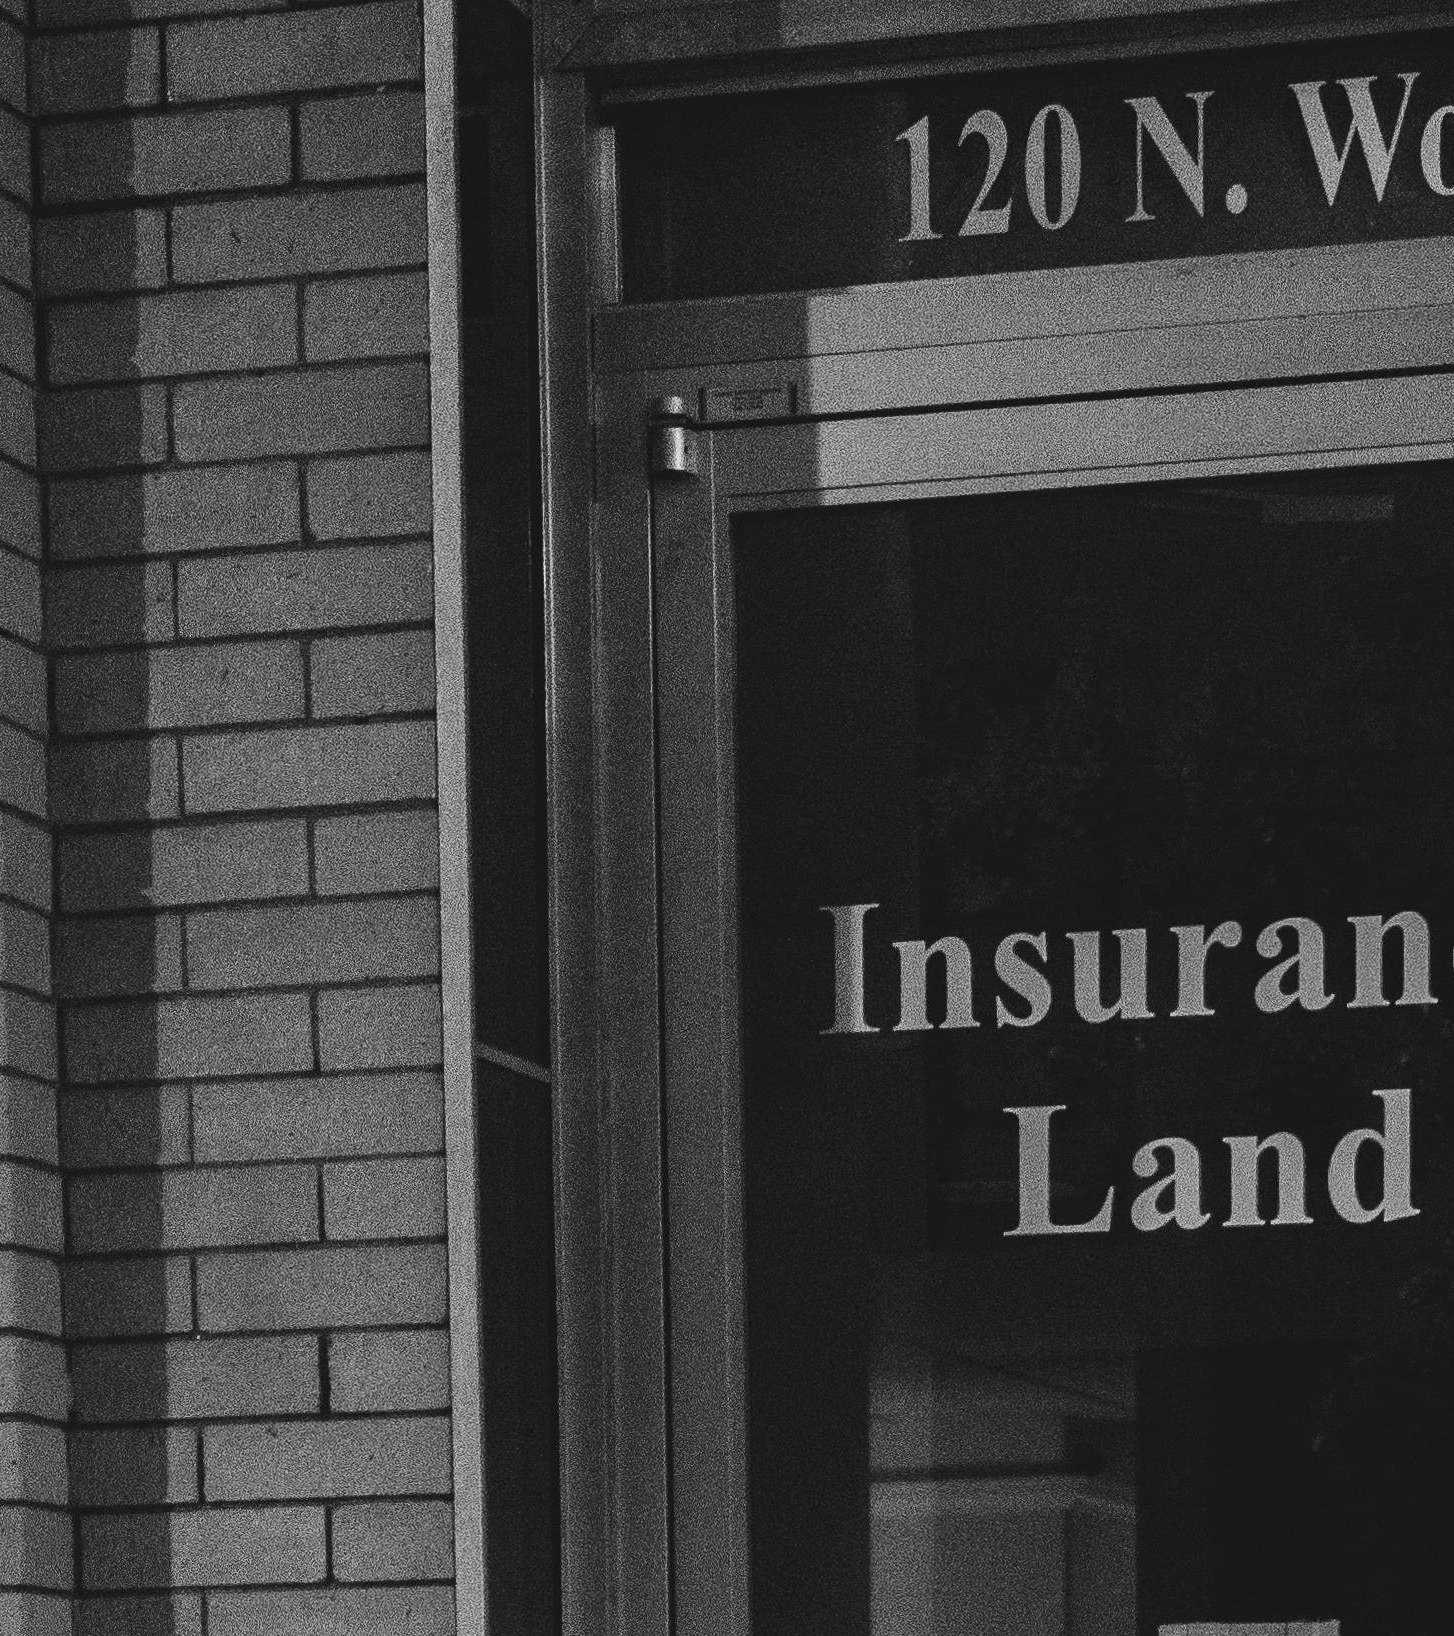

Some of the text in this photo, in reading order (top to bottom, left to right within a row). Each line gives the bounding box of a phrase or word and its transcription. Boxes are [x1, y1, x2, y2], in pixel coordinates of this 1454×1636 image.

[895, 102, 1083, 243] 120
[1124, 90, 1250, 223] N.
[1002, 1087, 1422, 1237] Land
